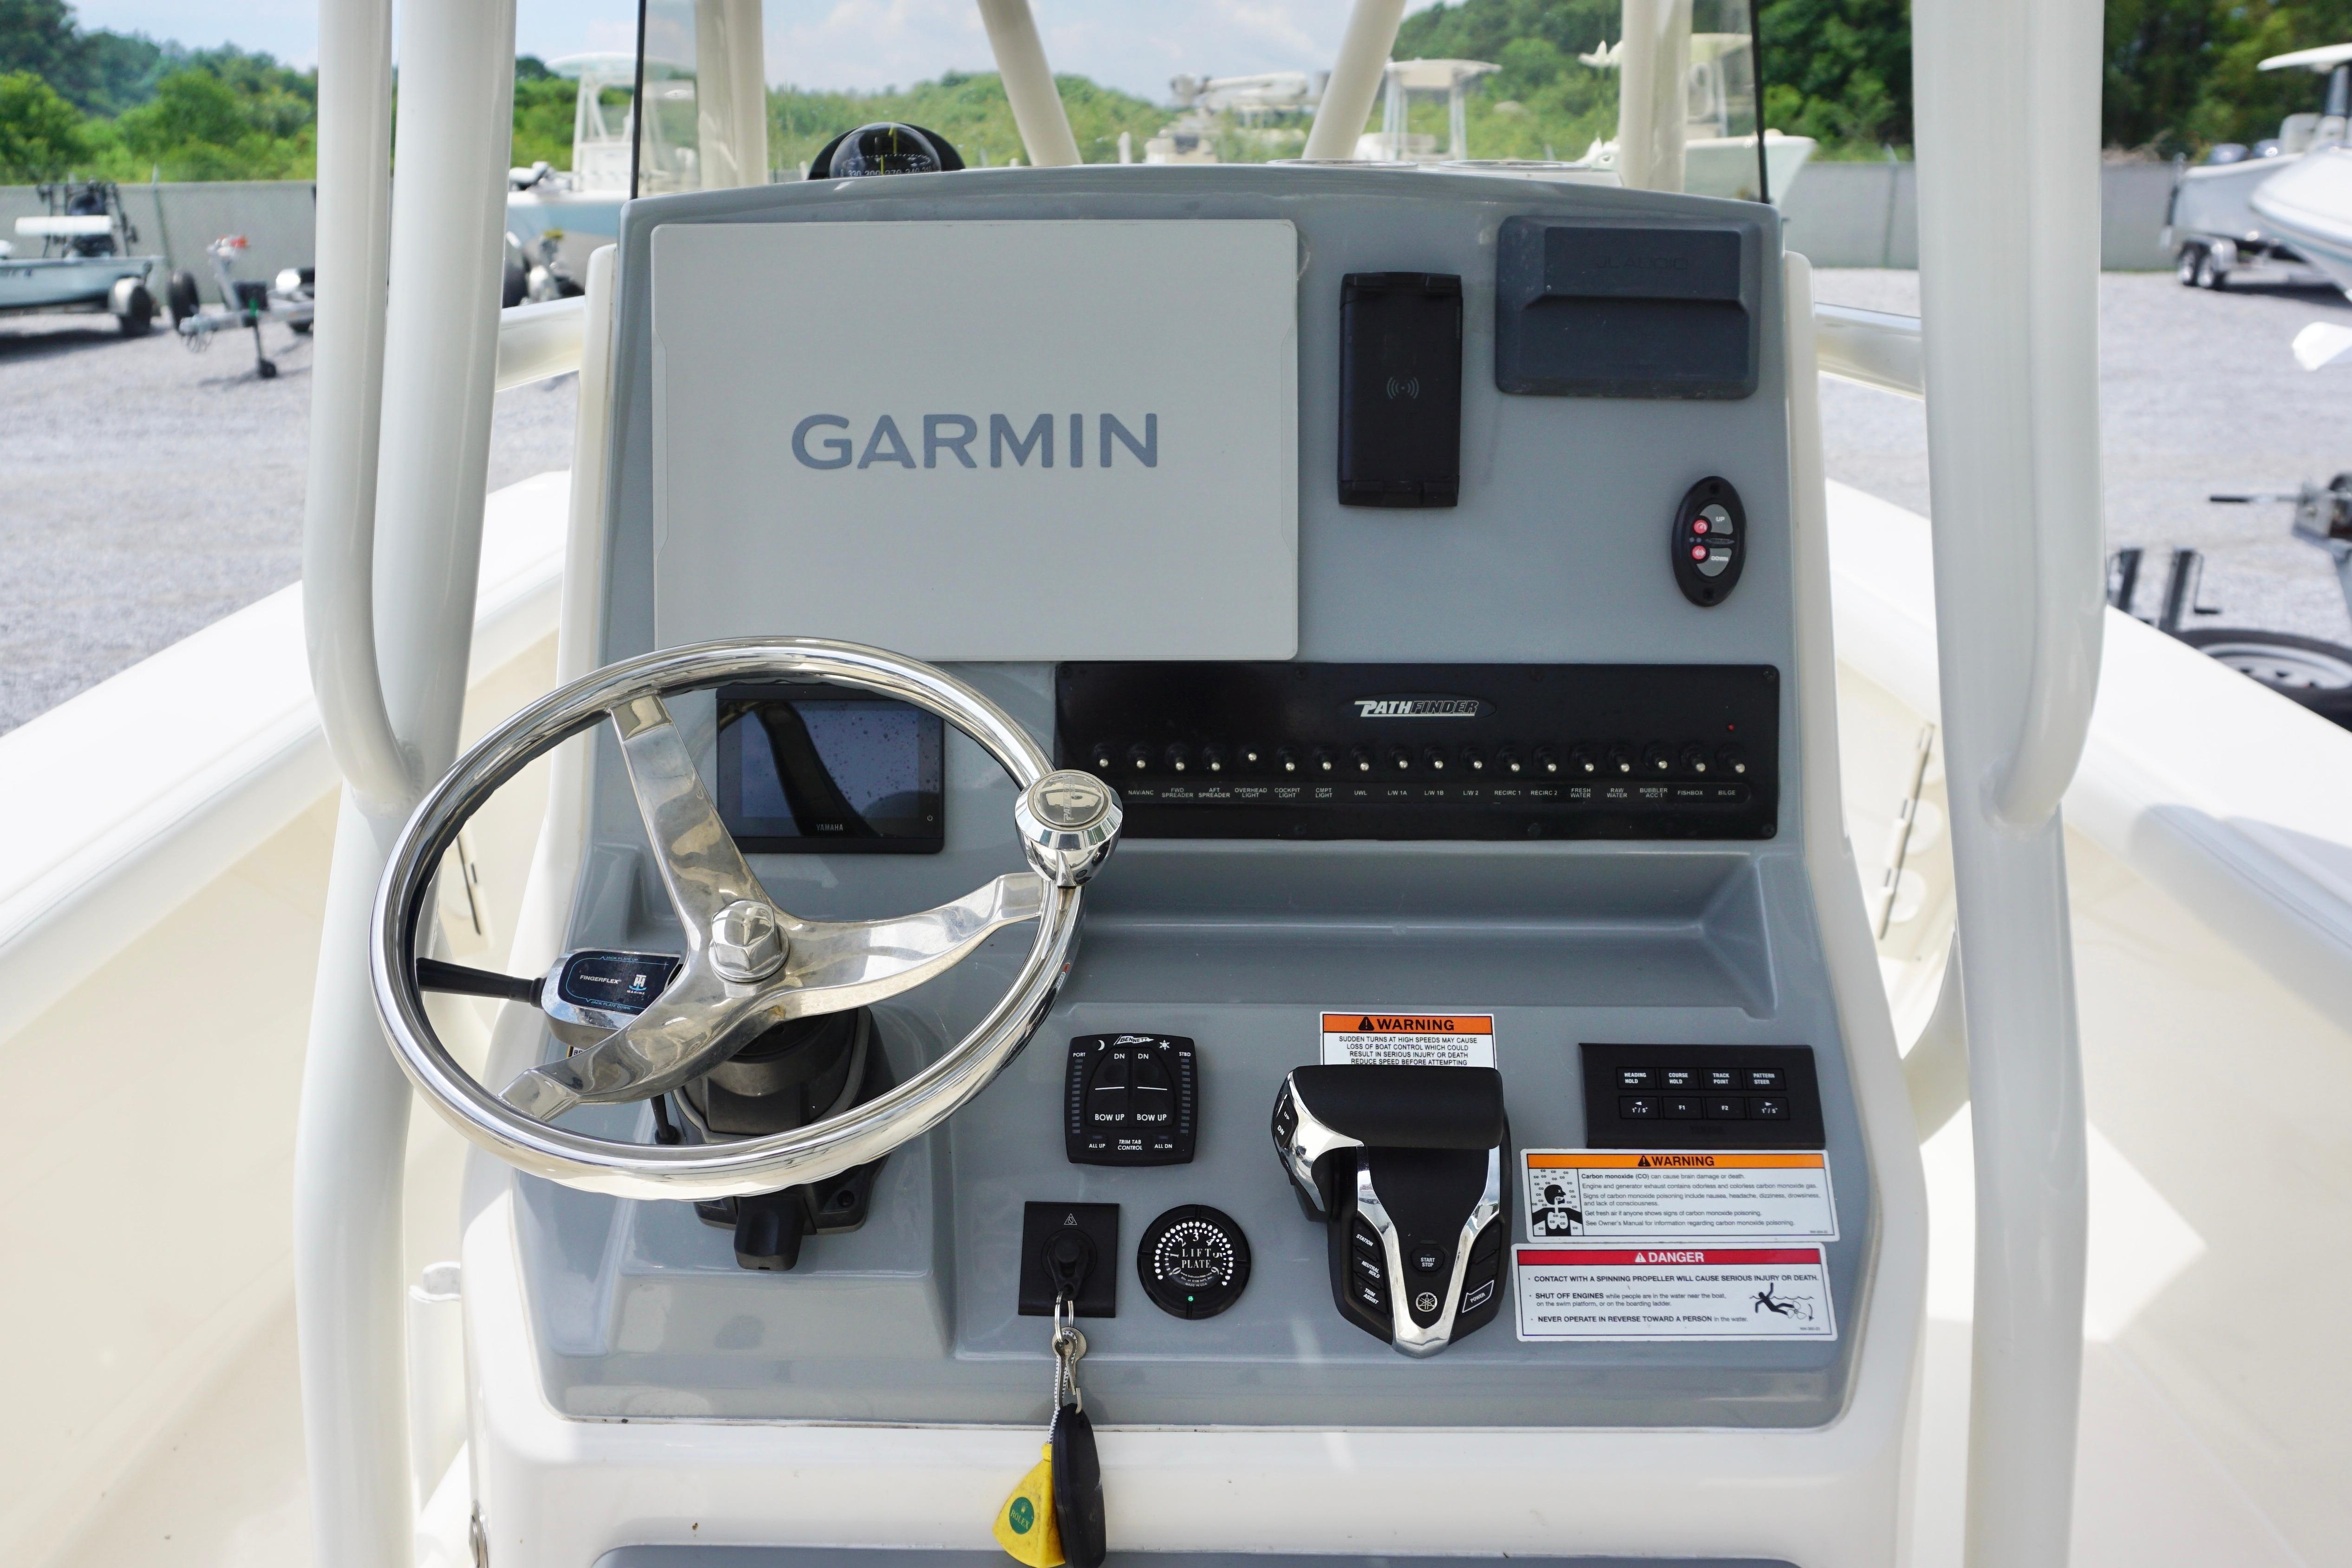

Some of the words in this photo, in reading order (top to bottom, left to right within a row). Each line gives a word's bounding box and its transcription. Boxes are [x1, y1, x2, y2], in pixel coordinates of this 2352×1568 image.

[791, 413, 1157, 470] GARMIN
[1355, 700, 1479, 717] PATHFINDER
[580, 975, 619, 984] FINGERFLEX
[1377, 1019, 1454, 1031] WARNING
[1284, 1111, 1290, 1120] UP
[1277, 1125, 1285, 1136] DN
[1650, 1155, 1714, 1167] WARNING
[1193, 1232, 1199, 1241] 3
[1356, 1234, 1373, 1247] STATION
[1178, 1238, 1186, 1247] 2
[1182, 1248, 1211, 1257] LIFT
[1648, 1252, 1704, 1263] DANGER
[1182, 1260, 1211, 1268] PLATE
[1362, 1260, 1379, 1274] NEUTRAL
[1368, 1268, 1380, 1279] HOLD
[1364, 1288, 1376, 1297] TRIM
[1470, 1292, 1486, 1303] POWER
[1363, 1293, 1379, 1304] ASSIST
[1010, 1509, 1030, 1529] ROLEX
